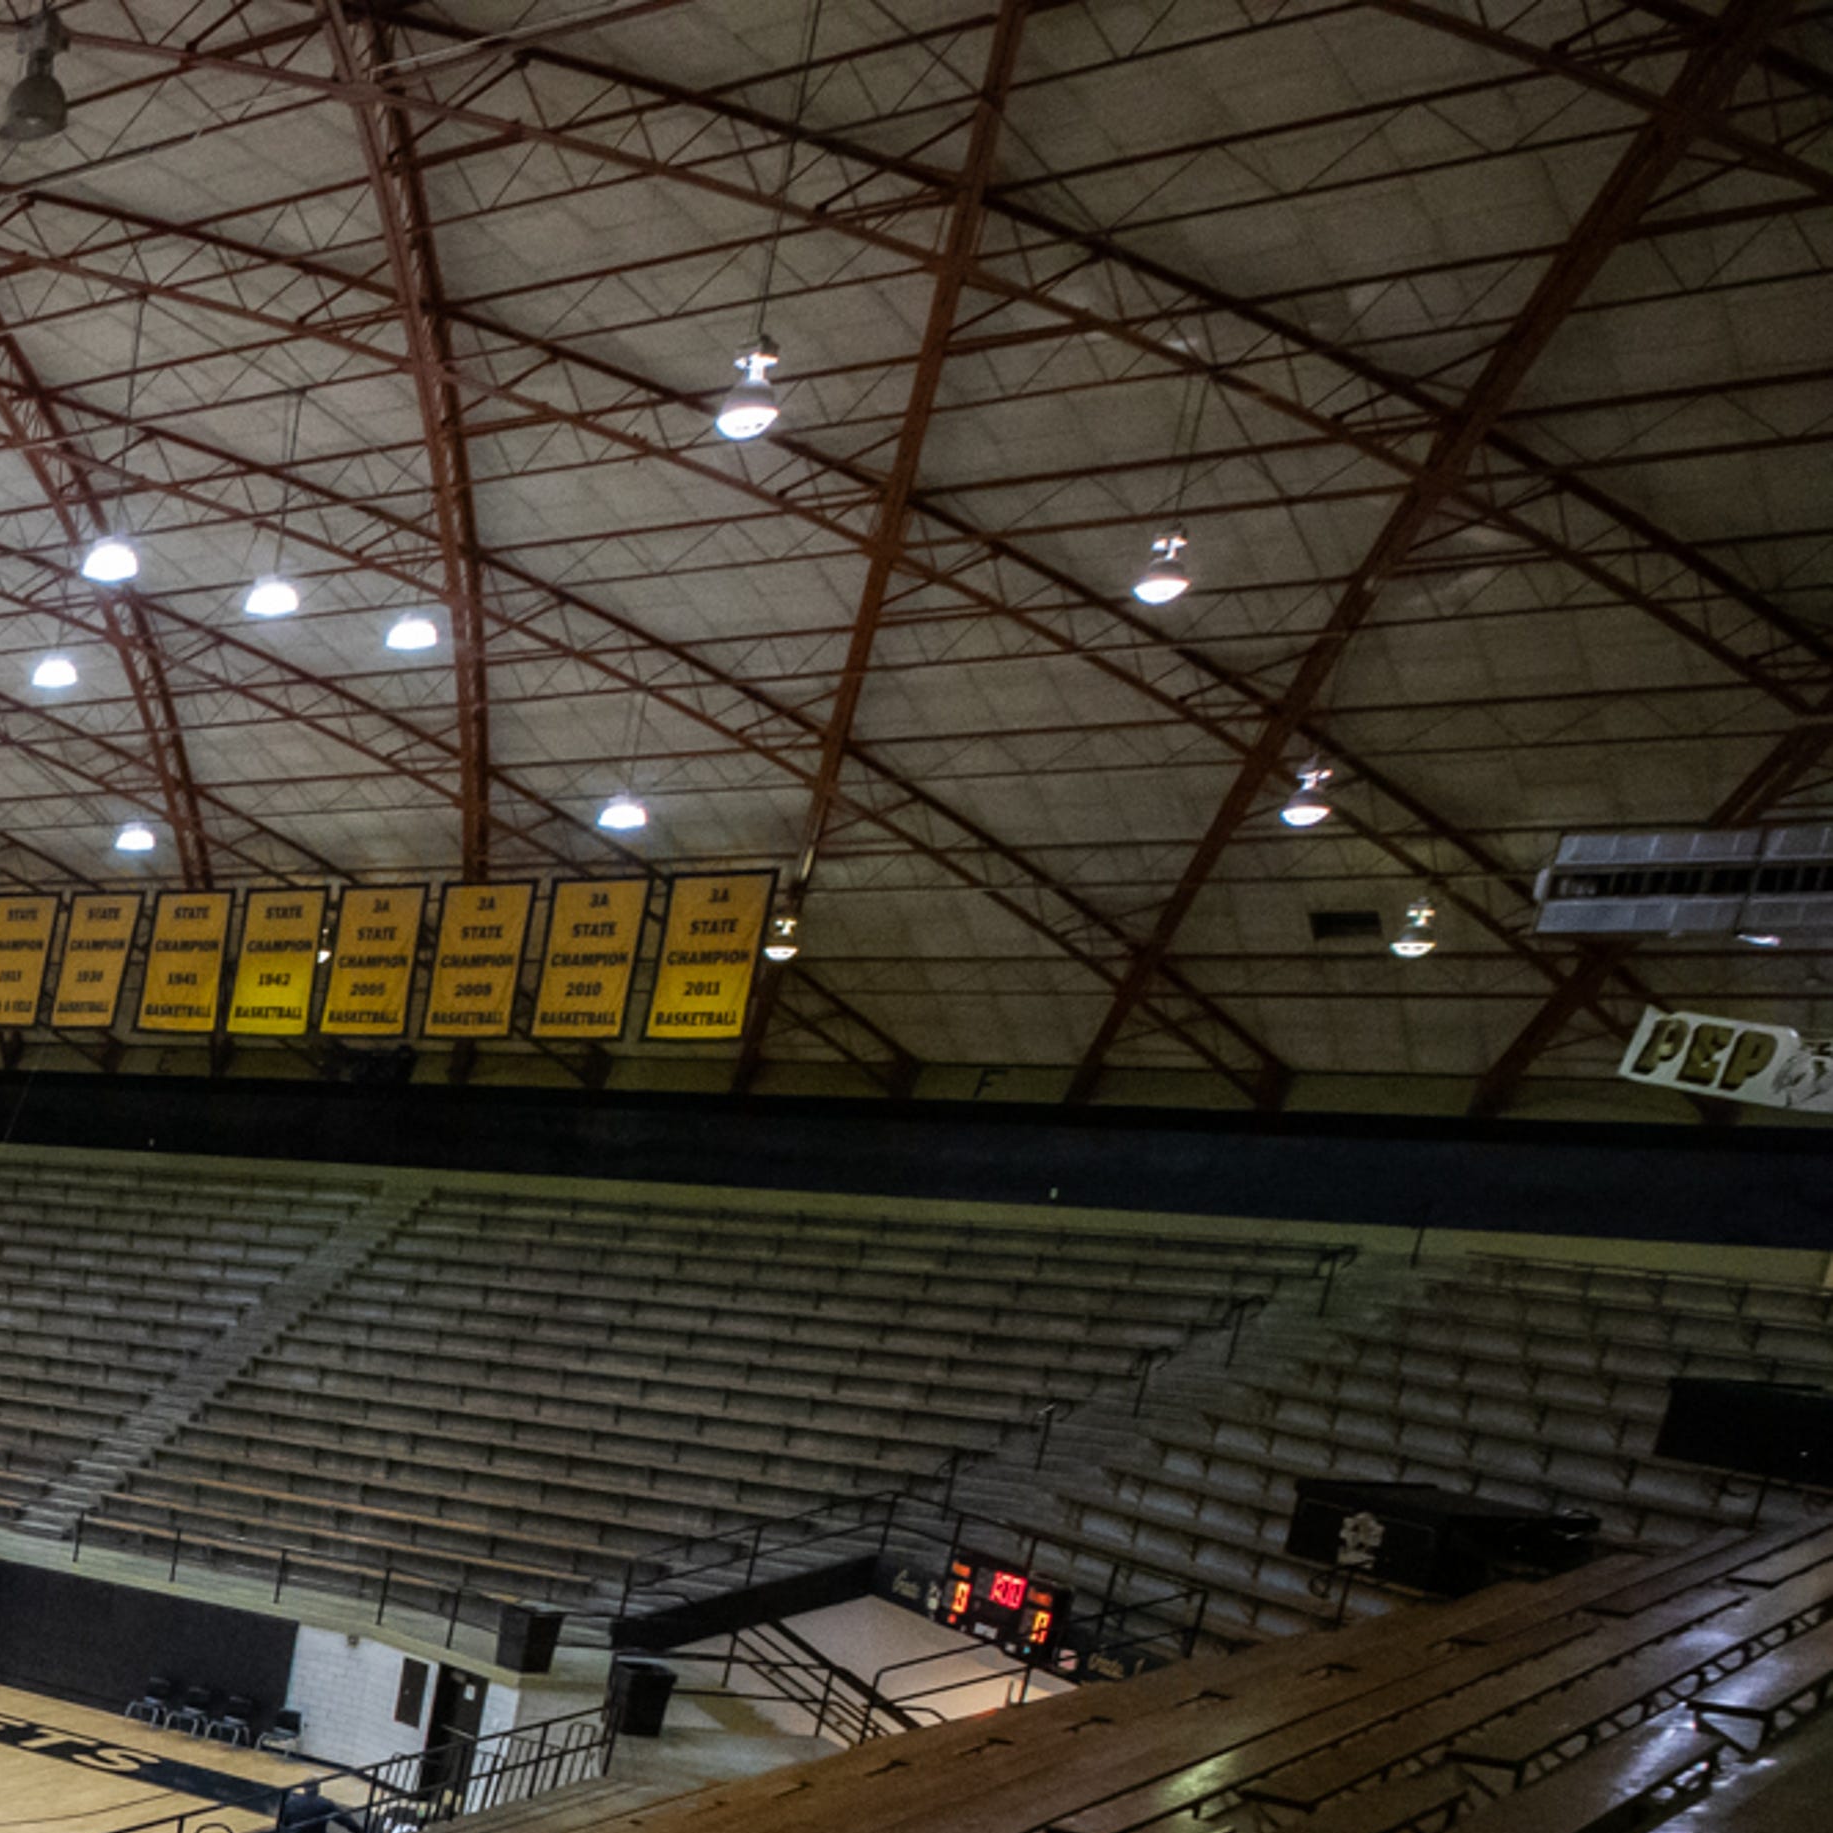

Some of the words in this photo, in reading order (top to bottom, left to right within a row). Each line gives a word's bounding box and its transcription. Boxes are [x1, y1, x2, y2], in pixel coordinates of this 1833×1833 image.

[173, 905, 209, 920] STATE
[264, 905, 303, 920] STATE
[356, 926, 397, 941] STATE
[461, 925, 503, 940] STATE
[571, 921, 617, 937] STATE
[689, 917, 740, 936] STATE
[154, 938, 219, 952] CHAMPION
[246, 939, 313, 954] CHAMPION
[337, 954, 407, 969] CHAMPION
[440, 954, 513, 969] CHAMPION
[550, 951, 628, 968] CHAMPION
[666, 950, 750, 966] CHAMPION
[684, 980, 721, 997] 2011
[144, 1002, 212, 1018] BASKETBALL
[234, 1005, 302, 1020] BASKETBALL
[328, 1009, 398, 1025] BASKETBALL
[430, 1010, 503, 1026] BASKETBALL
[540, 1011, 616, 1026] BASKETBALL
[654, 1010, 738, 1027] BASKETBALL
[1631, 1018, 1779, 1091] PEP
